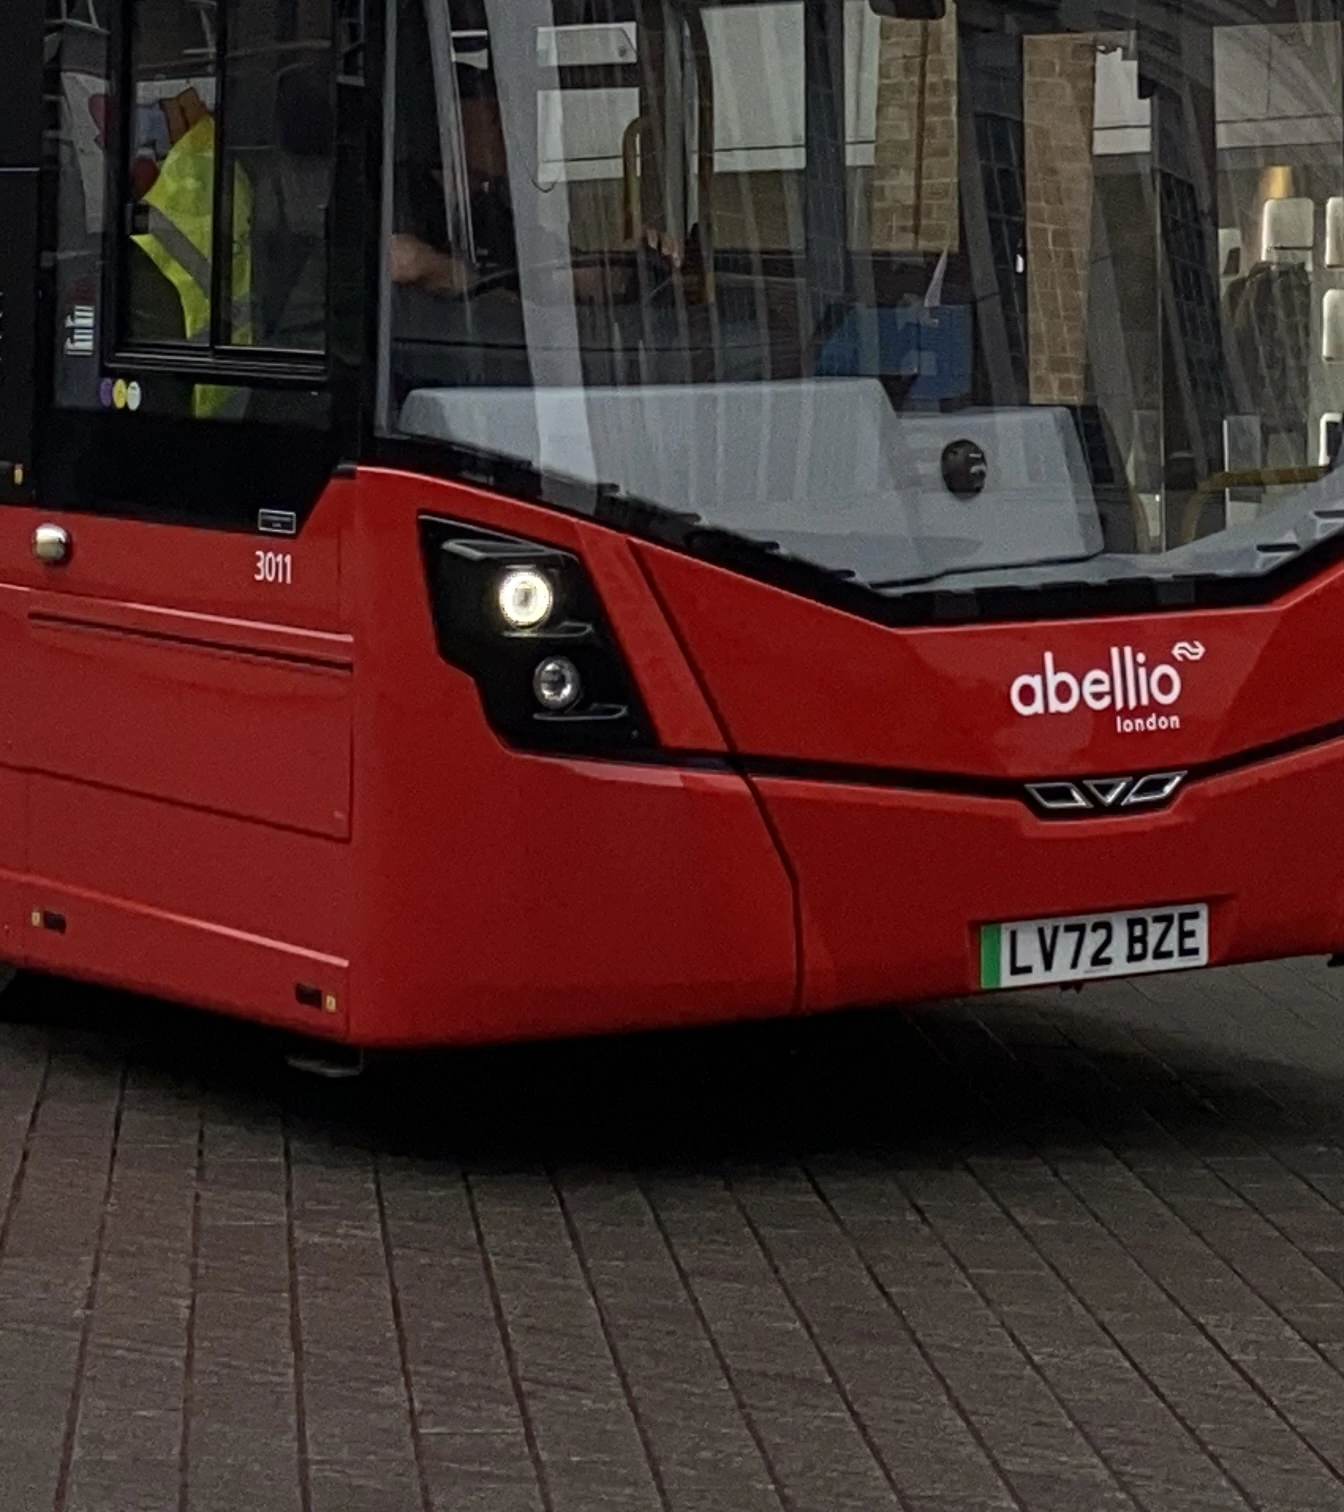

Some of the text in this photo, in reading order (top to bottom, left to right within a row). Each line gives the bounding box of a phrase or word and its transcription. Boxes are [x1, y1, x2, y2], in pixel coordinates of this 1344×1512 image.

[254, 550, 293, 584] 3011
[1009, 646, 1182, 717] abellio
[1116, 713, 1180, 733] london
[1008, 910, 1201, 977] LV72 BZE
